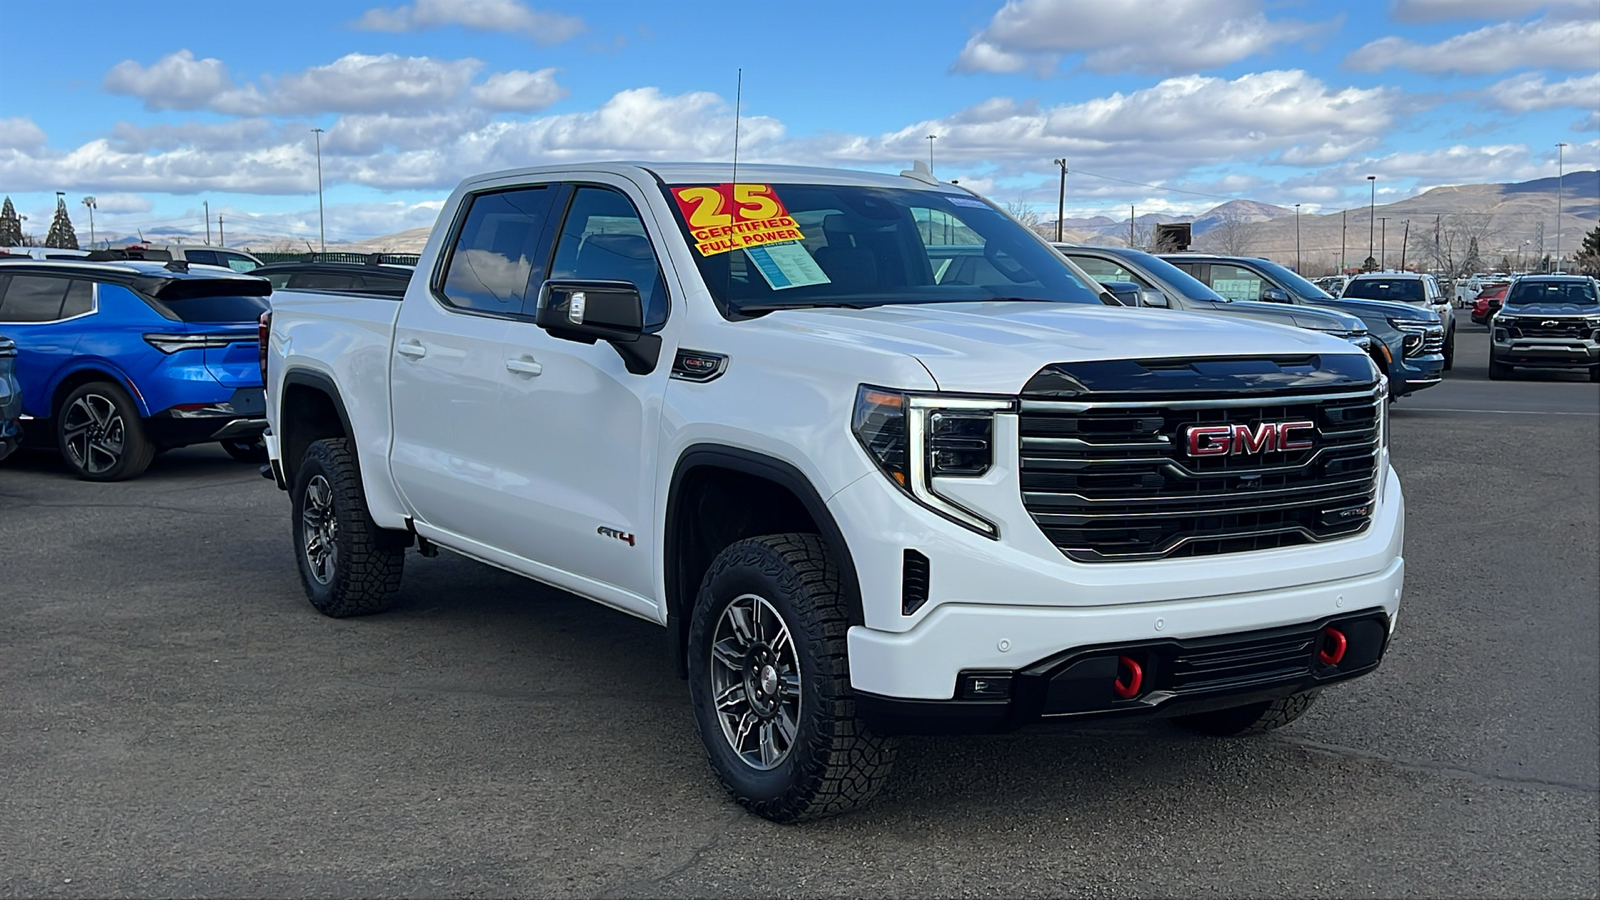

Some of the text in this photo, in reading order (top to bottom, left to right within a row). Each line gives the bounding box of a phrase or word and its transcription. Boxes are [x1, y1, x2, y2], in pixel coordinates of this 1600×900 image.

[678, 183, 784, 228] 25
[695, 218, 795, 241] CERTIFIED
[700, 229, 799, 254] FULL POWER
[1186, 421, 1314, 457] GMC
